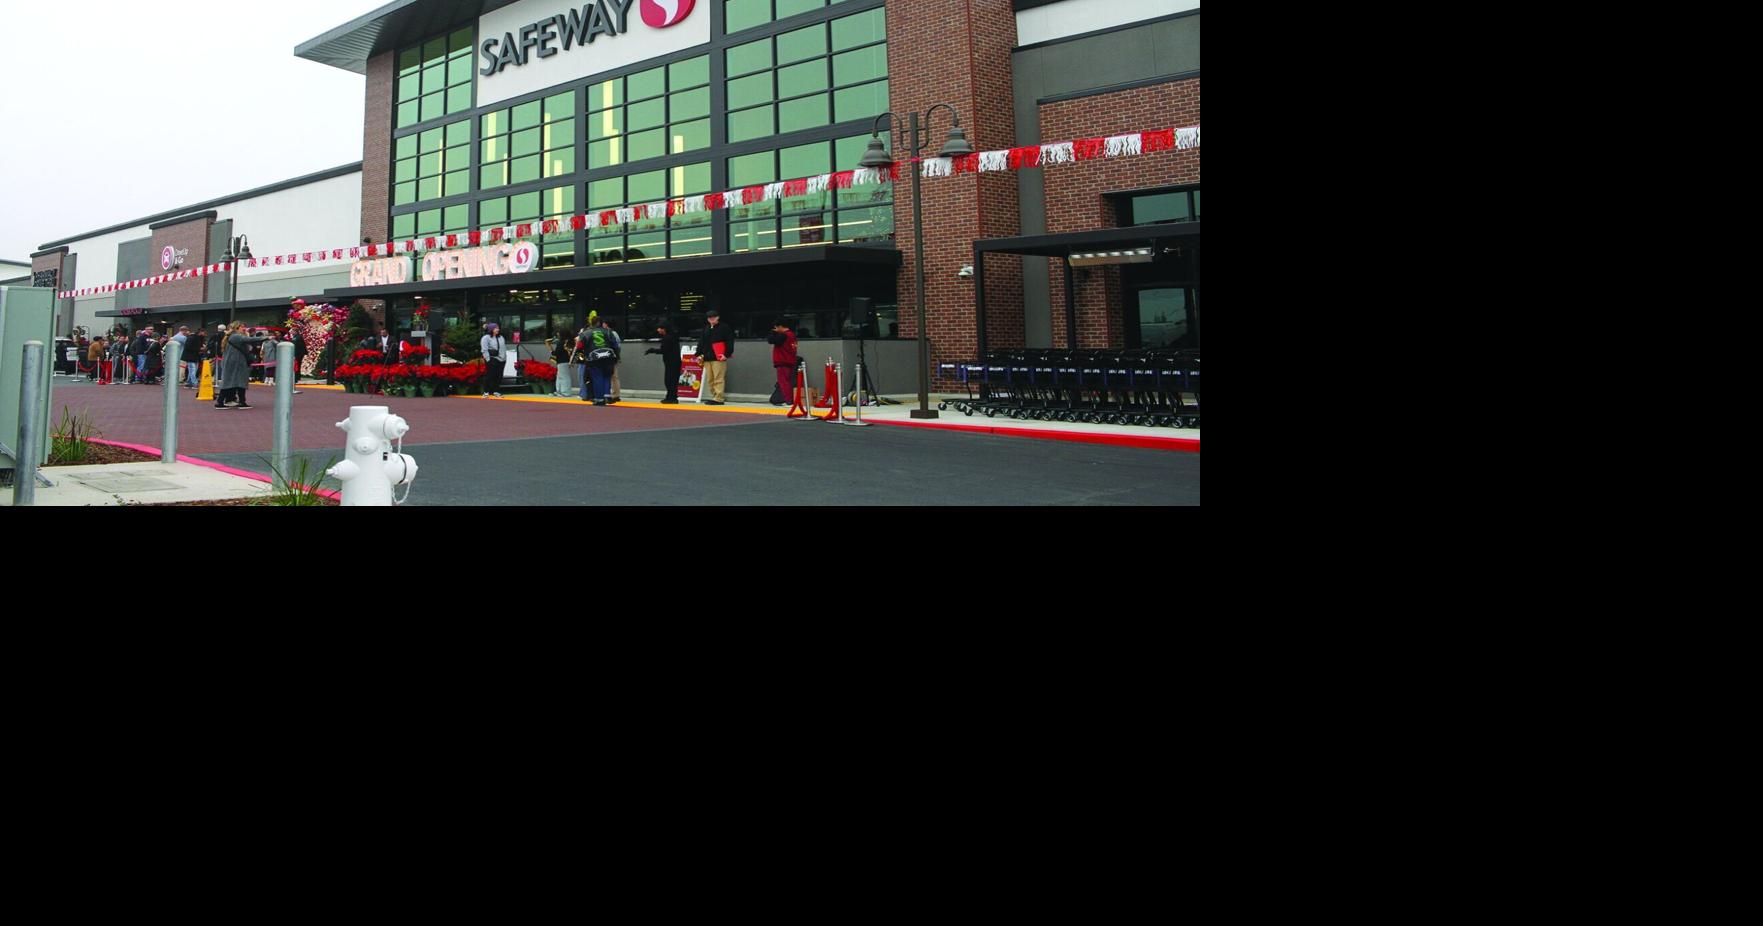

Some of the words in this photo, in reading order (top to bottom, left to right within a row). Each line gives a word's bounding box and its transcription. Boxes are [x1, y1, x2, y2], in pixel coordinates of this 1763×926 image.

[480, 0, 634, 76] SAFEWAY
[350, 257, 411, 286] GRAND
[422, 244, 512, 281] OPENING
